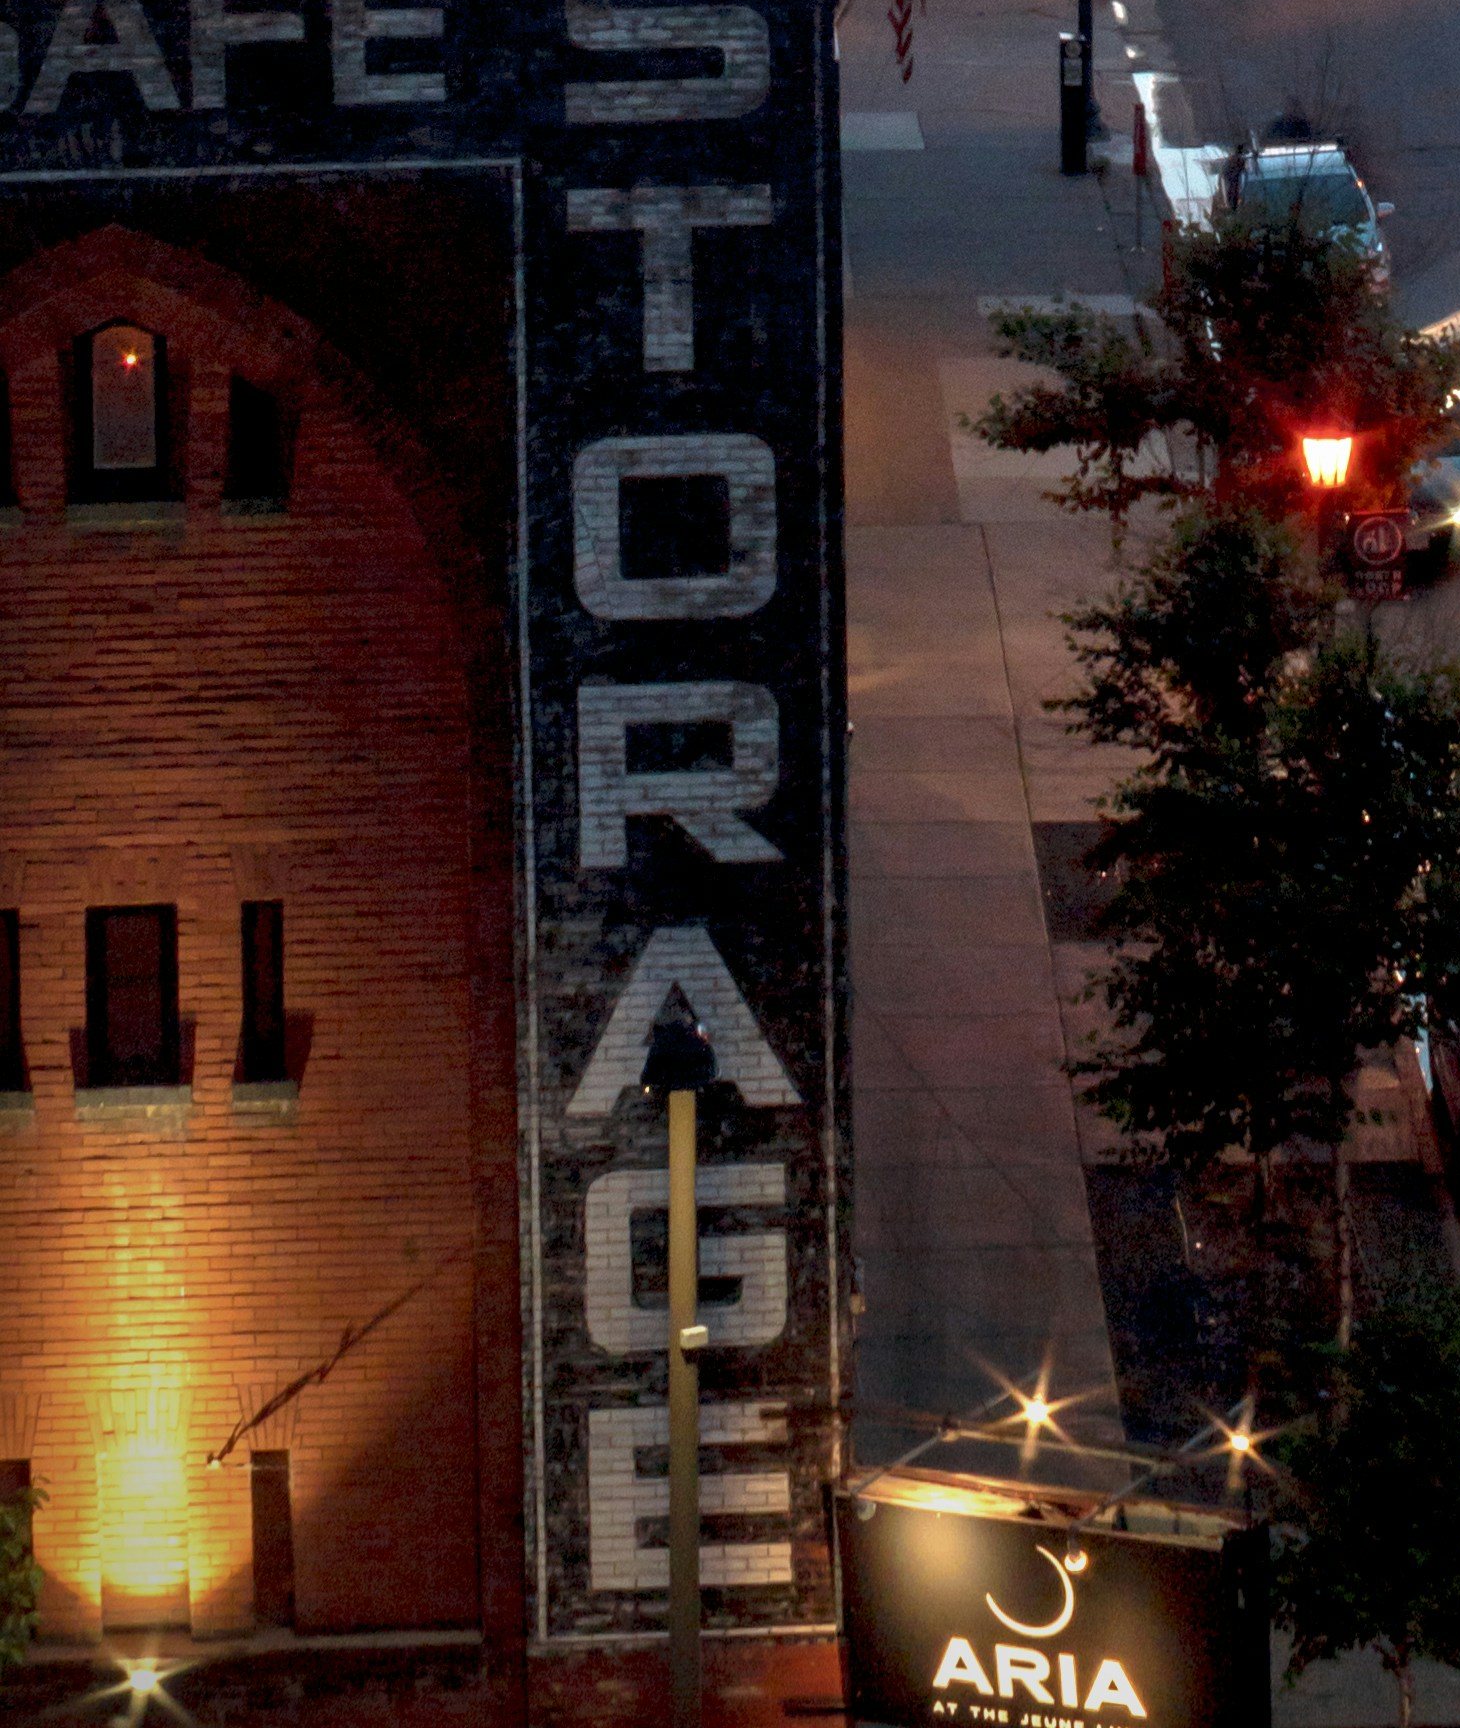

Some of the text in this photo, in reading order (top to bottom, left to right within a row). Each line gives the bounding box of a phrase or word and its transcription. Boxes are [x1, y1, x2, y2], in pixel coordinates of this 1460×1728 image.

[932, 1635, 1147, 1719] ARIA
[932, 1700, 958, 1716] AT
[969, 1705, 1009, 1723] THE
